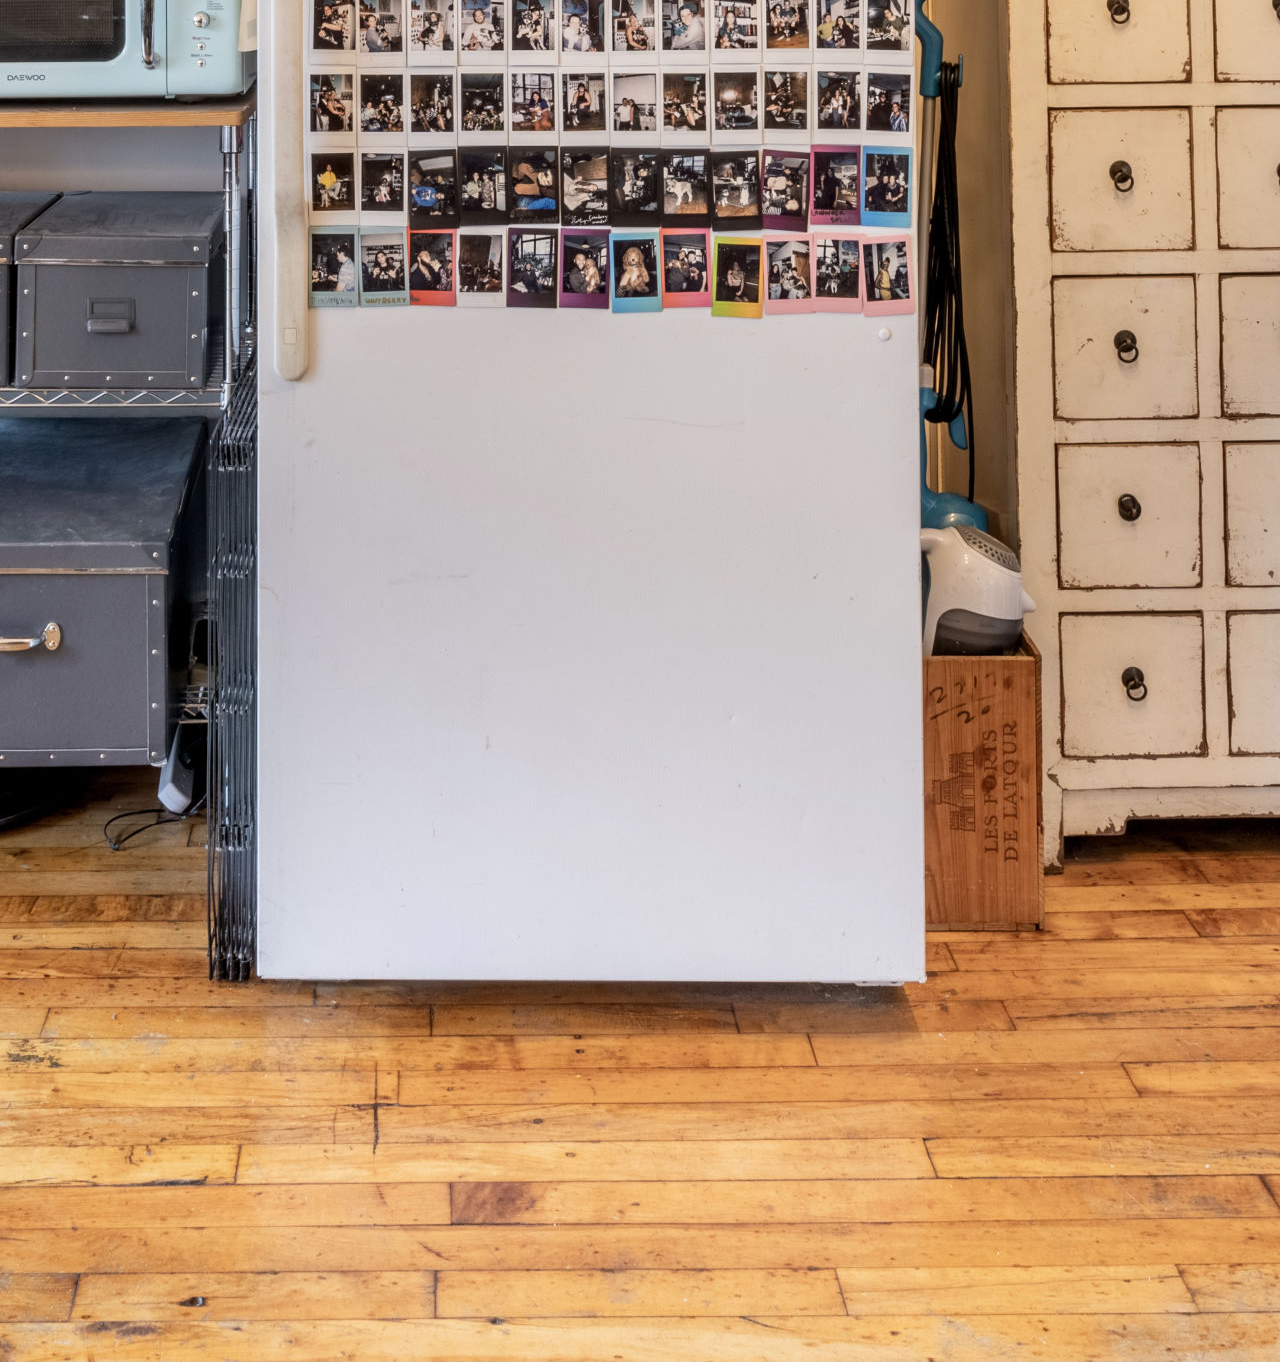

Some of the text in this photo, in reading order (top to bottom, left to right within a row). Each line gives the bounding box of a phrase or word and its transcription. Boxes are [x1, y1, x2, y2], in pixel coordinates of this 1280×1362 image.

[982, 730, 999, 854] LES FORTS
[1002, 830, 1019, 863] DE
